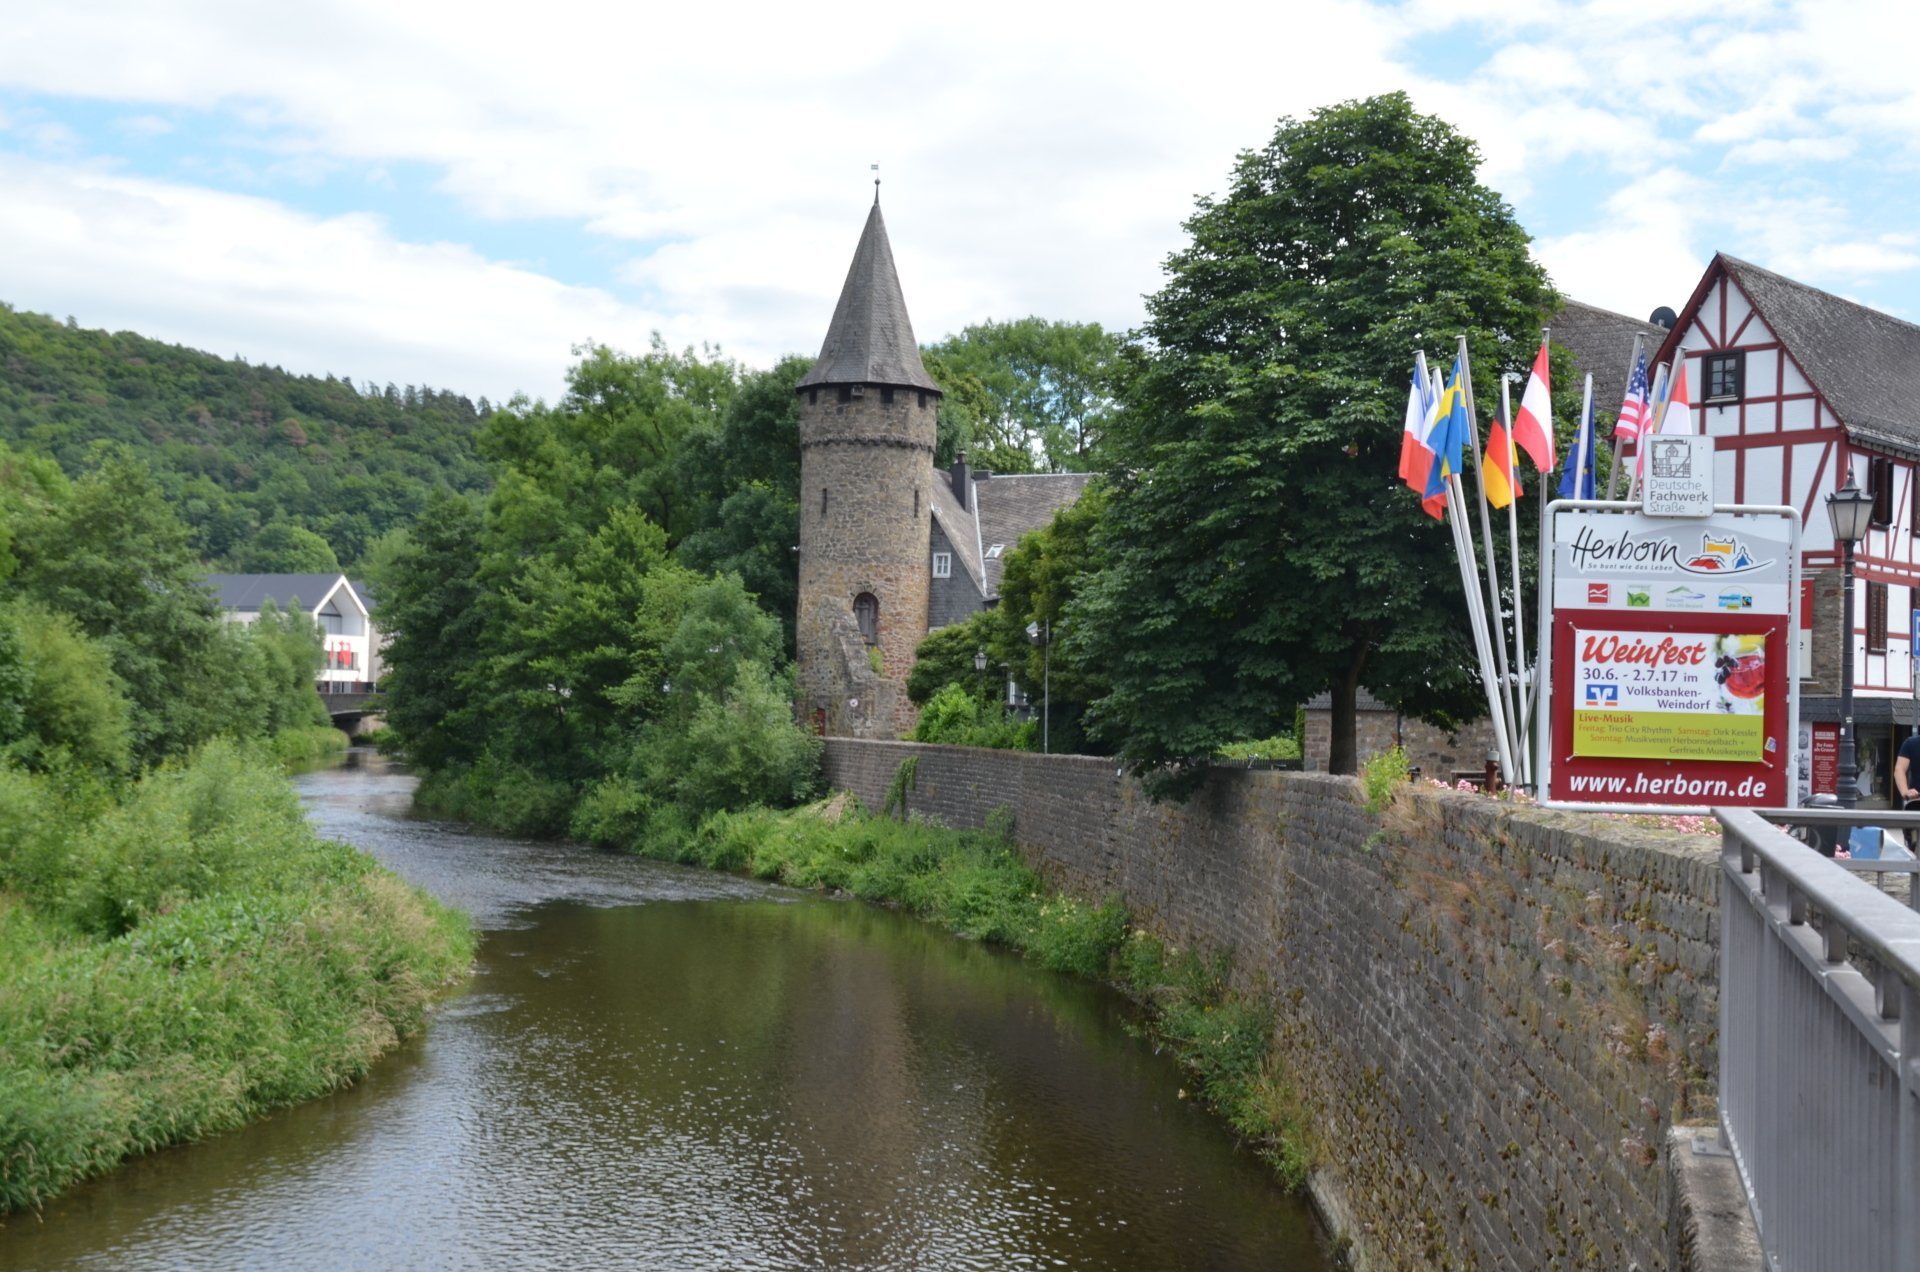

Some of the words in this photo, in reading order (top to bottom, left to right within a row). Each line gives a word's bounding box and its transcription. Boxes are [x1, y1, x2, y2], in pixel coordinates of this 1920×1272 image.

[1650, 479, 1702, 490] Deutsche
[1650, 490, 1709, 502] Fachwerk
[1650, 501, 1686, 513] Straße
[1570, 525, 1677, 570] Herborn
[1581, 635, 1707, 668] Weinfest
[1583, 667, 1619, 681] 30.6.
[1633, 669, 1678, 683] 2.7.17
[1683, 672, 1698, 683] im
[1626, 685, 1702, 698] Volksbanken-
[1657, 699, 1711, 711] Weindorf
[1579, 713, 1633, 723] Live-Musik
[1578, 724, 1606, 733] Freitag:
[1608, 724, 1622, 733] Trio
[1624, 725, 1640, 734] City
[1641, 726, 1672, 735] Rhythm
[1713, 728, 1730, 736] Dirk
[1732, 729, 1757, 737] Kessler
[1625, 736, 1671, 745] Musikverein
[1706, 747, 1758, 757] Musikexpress
[1570, 772, 1767, 798] www.herborn.de
